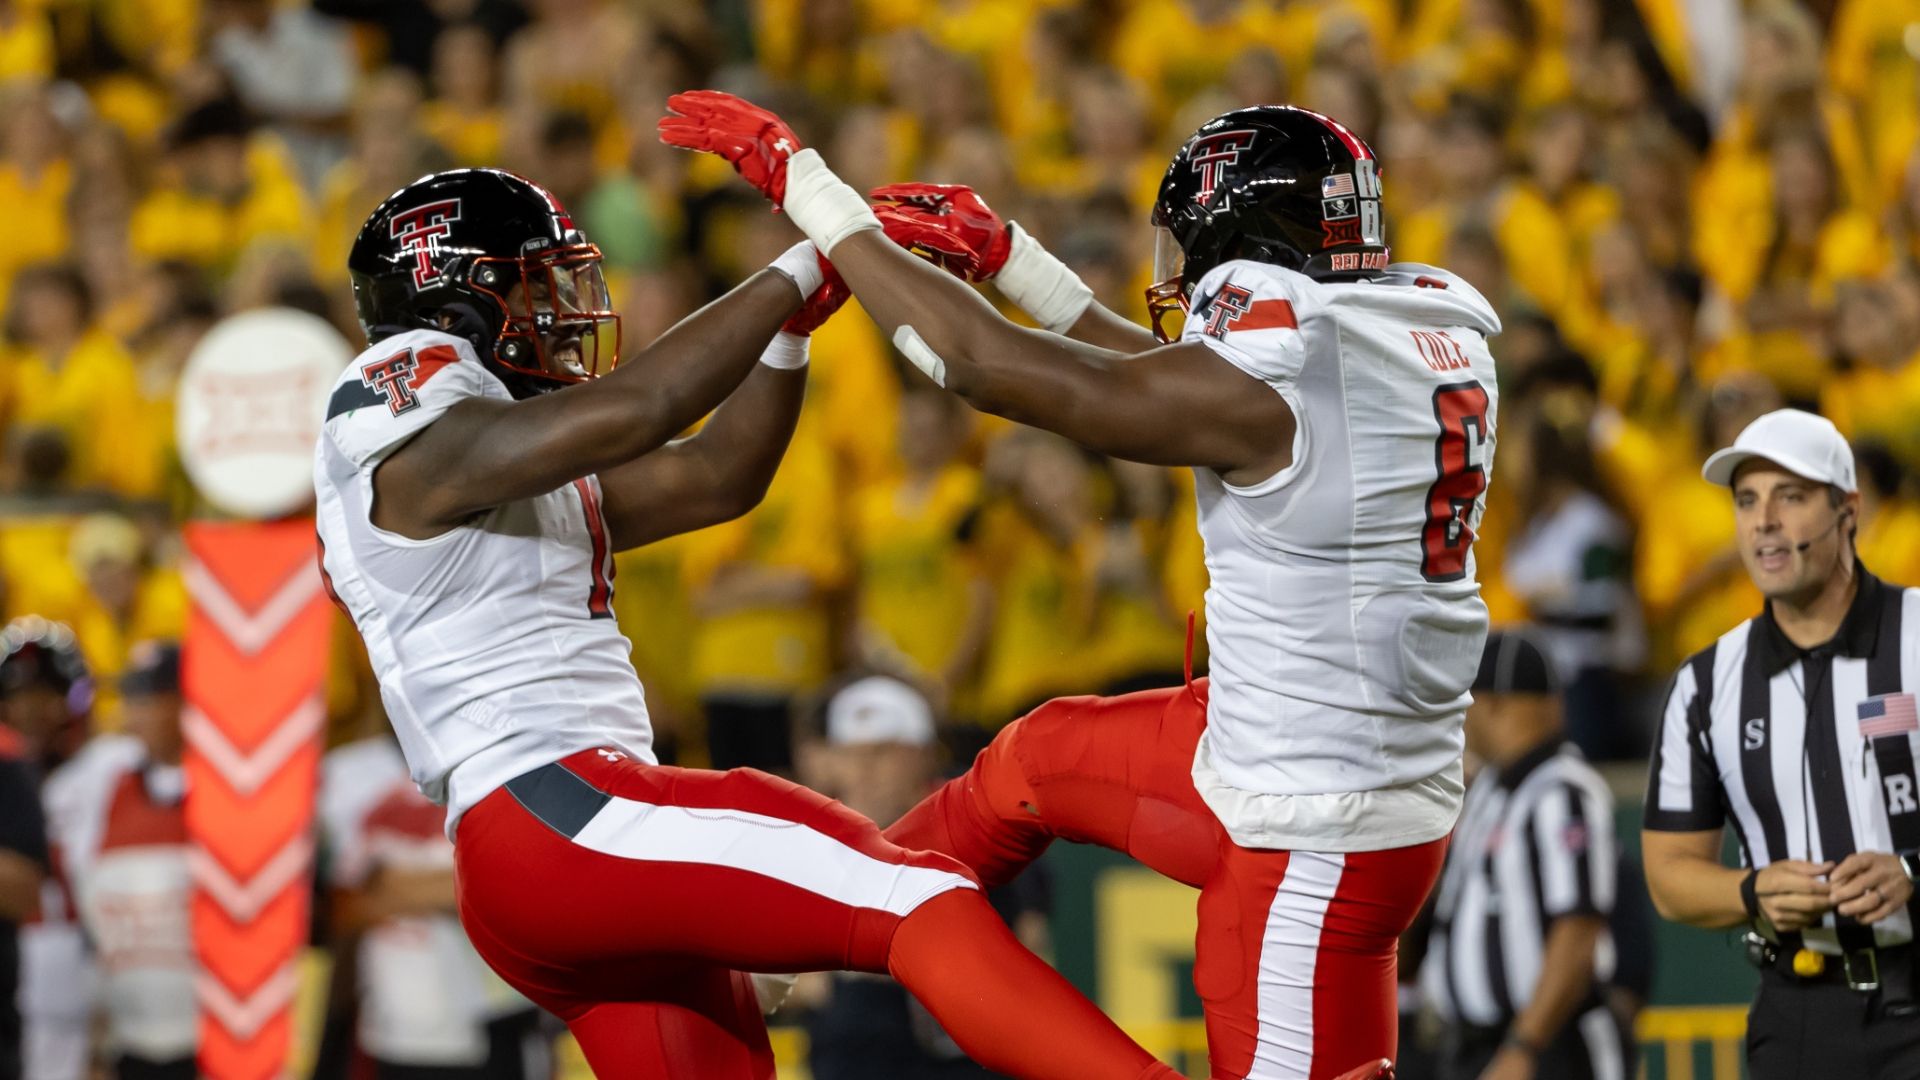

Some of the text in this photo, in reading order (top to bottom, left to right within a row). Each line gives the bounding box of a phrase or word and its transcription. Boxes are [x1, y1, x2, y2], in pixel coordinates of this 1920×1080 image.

[1331, 253, 1360, 271] RED
[1409, 331, 1470, 371] COLE
[1420, 380, 1489, 582] 6
[1744, 718, 1765, 750] S
[1884, 774, 1916, 815] R
